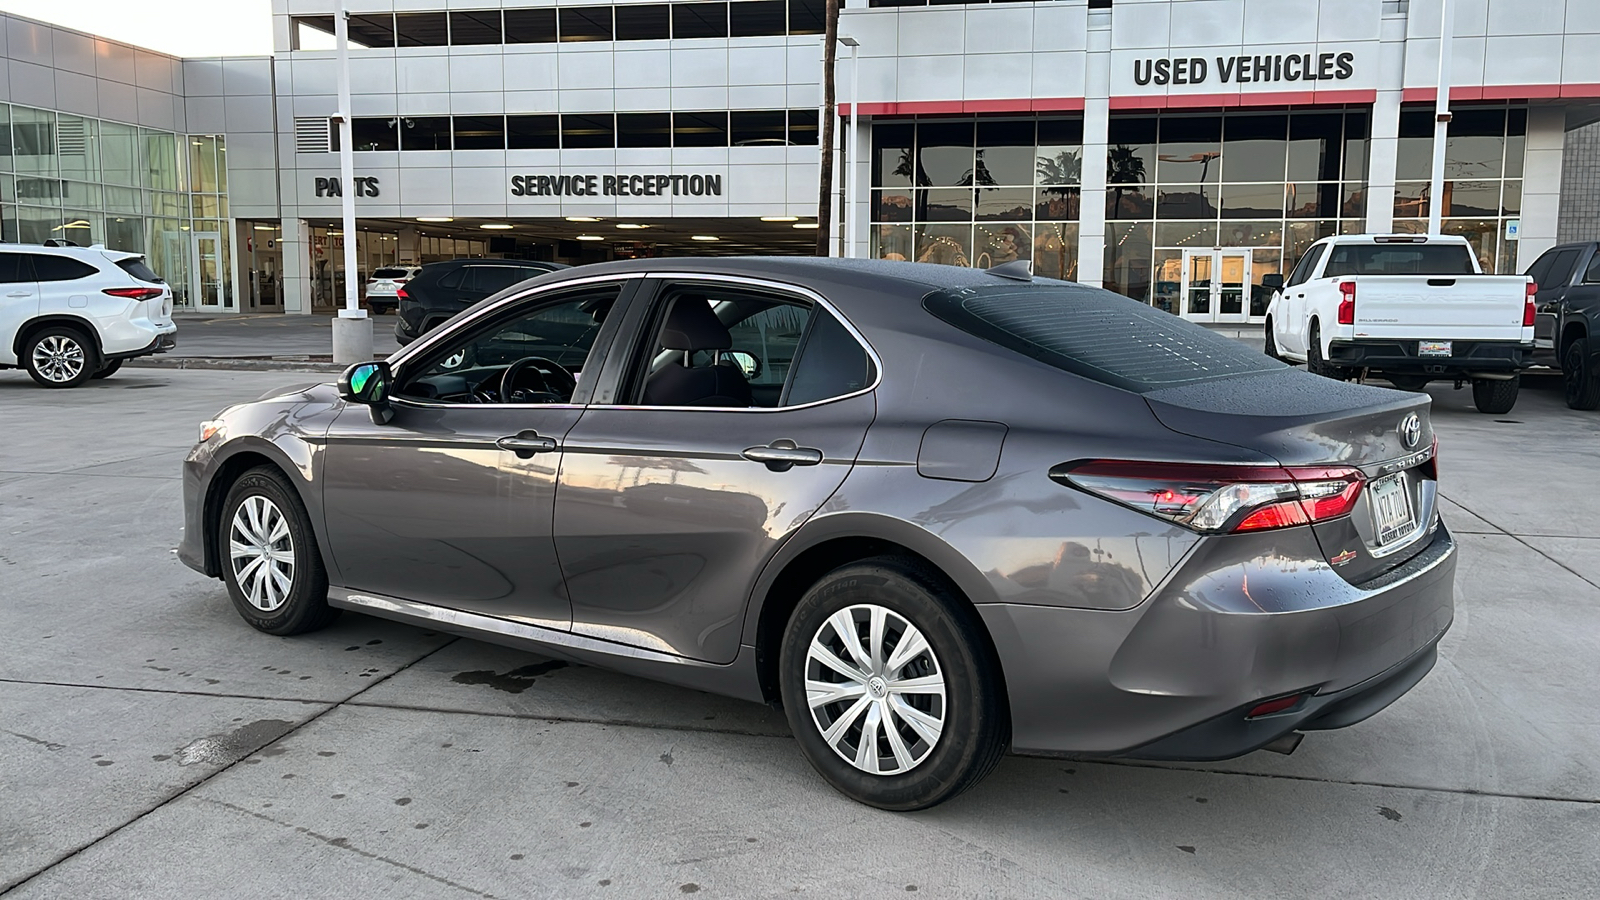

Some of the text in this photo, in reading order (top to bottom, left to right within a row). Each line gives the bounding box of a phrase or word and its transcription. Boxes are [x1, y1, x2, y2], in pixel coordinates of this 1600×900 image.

[1134, 52, 1354, 86] USED VEHICLES
[314, 176, 380, 197] PATS
[511, 175, 721, 196] SERVICE RECEPTION
[1381, 530, 1399, 544] DESERT
[1399, 522, 1415, 537] TOYOTA
